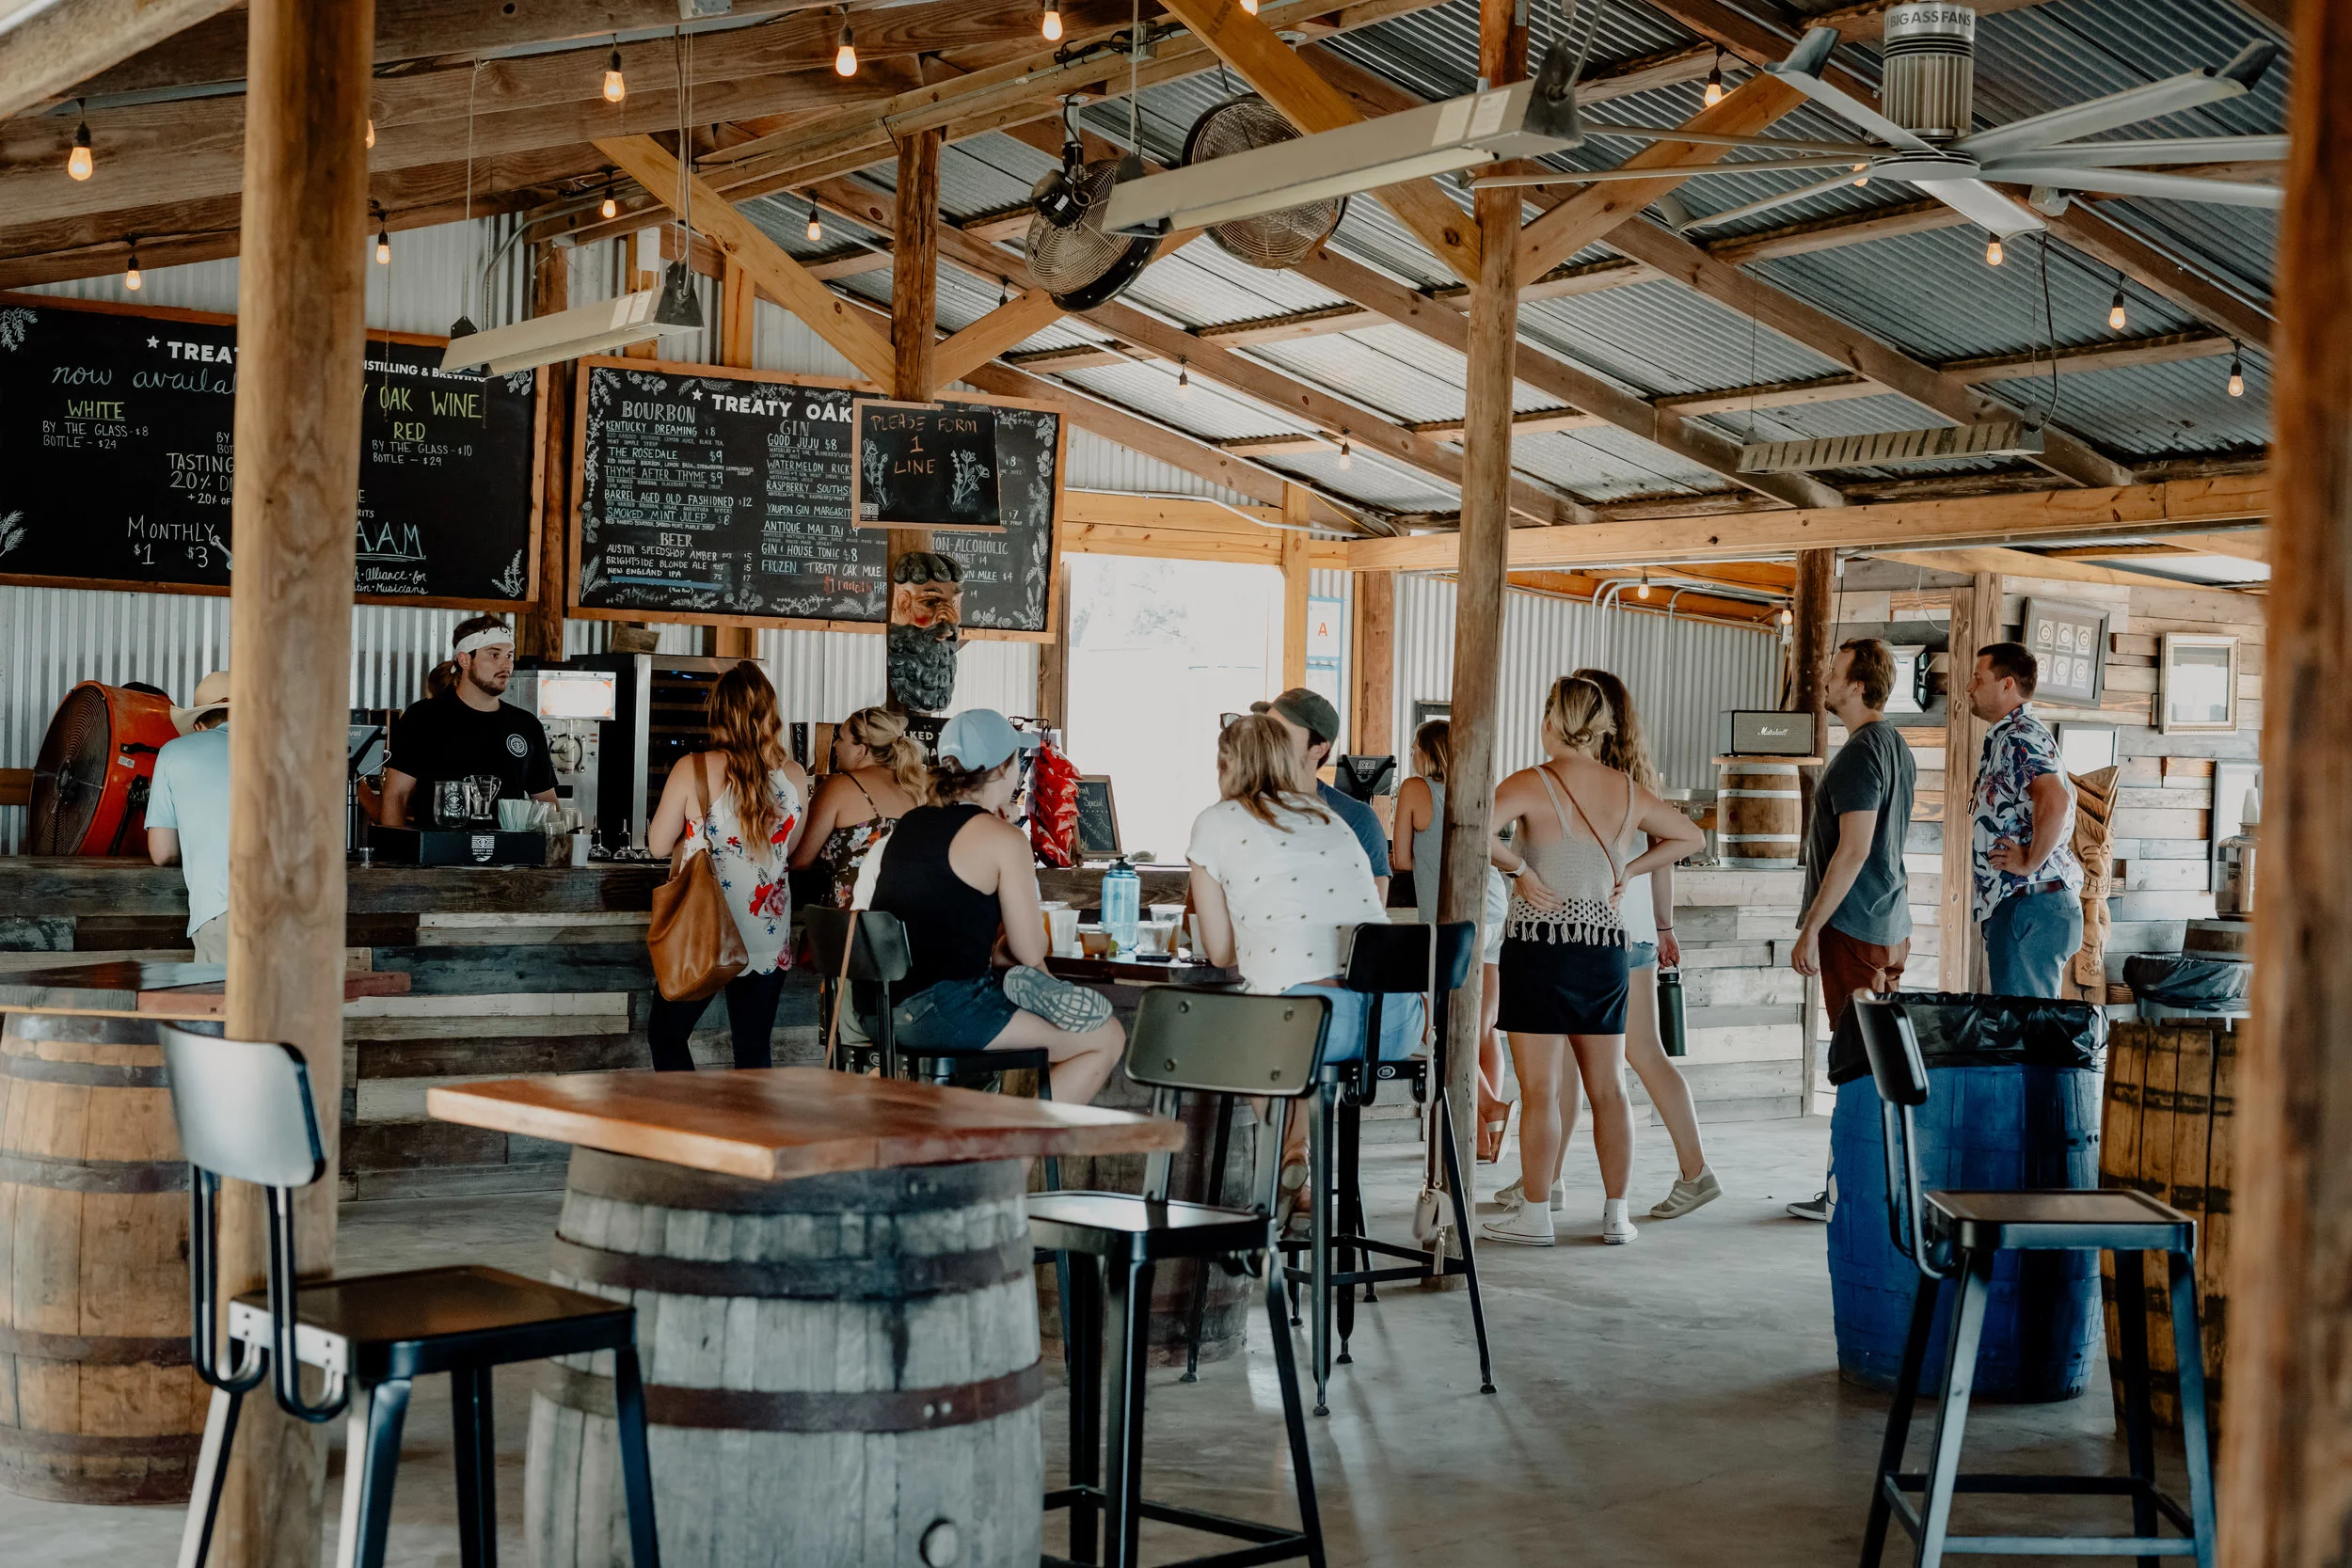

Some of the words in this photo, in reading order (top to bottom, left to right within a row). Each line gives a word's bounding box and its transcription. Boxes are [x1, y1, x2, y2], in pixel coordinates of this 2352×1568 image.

[1890, 13, 1909, 28] BIG
[1912, 11, 1939, 24] ASS
[1942, 11, 1971, 26] FANS
[52, 366, 112, 386] now
[363, 360, 418, 375] ISTILLING
[421, 368, 428, 376] &
[68, 399, 125, 420] WHITE
[380, 386, 413, 412] OAK
[432, 391, 482, 418] WINE
[711, 393, 792, 418] TREATY
[805, 403, 852, 423] OAK
[621, 401, 696, 423] BOURBON
[42, 420, 56, 434] BY
[65, 422, 87, 435] THE
[394, 421, 425, 441] RED
[606, 420, 646, 434] KENTUCKY
[655, 424, 697, 436] DREAMING
[779, 420, 810, 436] GIN
[938, 418, 977, 433] FORM
[43, 436, 84, 448] BOTTLE
[99, 439, 117, 450] $24
[216, 432, 230, 443] BY
[767, 434, 790, 447] GOOD
[797, 436, 819, 449] JUJU
[825, 438, 837, 451] $8
[910, 436, 924, 453] 1
[217, 445, 233, 454] BOT
[372, 439, 384, 451] BY
[389, 441, 412, 452] THE
[418, 443, 449, 454] GLASS
[458, 445, 472, 457] $10
[607, 446, 628, 457] THE
[632, 448, 677, 460] ROSEDALE
[709, 450, 723, 464] $9
[167, 452, 234, 473] TASTING
[373, 452, 405, 464] BOTTLE
[423, 456, 442, 466] $29
[767, 459, 824, 472] WATERMELON
[894, 459, 936, 475] LINE
[170, 470, 211, 489] 20%
[604, 465, 636, 478] THYME
[642, 469, 669, 481] AFTER
[676, 469, 706, 482] THYME
[710, 471, 723, 484] $9
[766, 480, 809, 493] RASPBERRY
[198, 493, 217, 504] 20%
[604, 489, 635, 501] BARREL
[641, 492, 660, 503] AGED
[666, 493, 681, 504] OLD
[688, 495, 734, 507] FASHIONED
[356, 509, 374, 518] RITS
[606, 506, 643, 518] SMOKED
[650, 510, 676, 521] MINT
[679, 512, 707, 522] JULEP
[717, 515, 730, 526] $8
[767, 502, 794, 515] YAUPON
[795, 504, 809, 515] GIN
[764, 520, 801, 533] ANTIQUE
[807, 523, 824, 534] MAI
[830, 525, 844, 536] TAI
[660, 532, 692, 547] BEER
[134, 543, 155, 565] $1
[187, 546, 208, 568] $3
[606, 544, 635, 555] AUSTIN
[642, 546, 685, 558] SPEEDSHOP
[690, 550, 718, 562] AMBER
[761, 543, 777, 555] GIN
[787, 545, 813, 557] HOUSE
[818, 546, 840, 558] TONIC
[842, 547, 858, 562] $8
[606, 556, 654, 567] BRIGHTSIDE
[660, 559, 688, 569] BLONDE
[691, 562, 707, 570] ALE
[761, 560, 797, 574] FROZEN
[804, 562, 837, 576] TREATY
[842, 563, 857, 577] OAK
[862, 565, 882, 578] MULE
[412, 570, 427, 584] for
[626, 567, 662, 577] ENGLAND
[978, 570, 997, 580] MULE
[1002, 572, 1013, 583] $4
[1318, 623, 1327, 637] A
[348, 729, 361, 737] vel
[903, 730, 934, 741] LKED
[1756, 726, 1788, 736] Marshall
